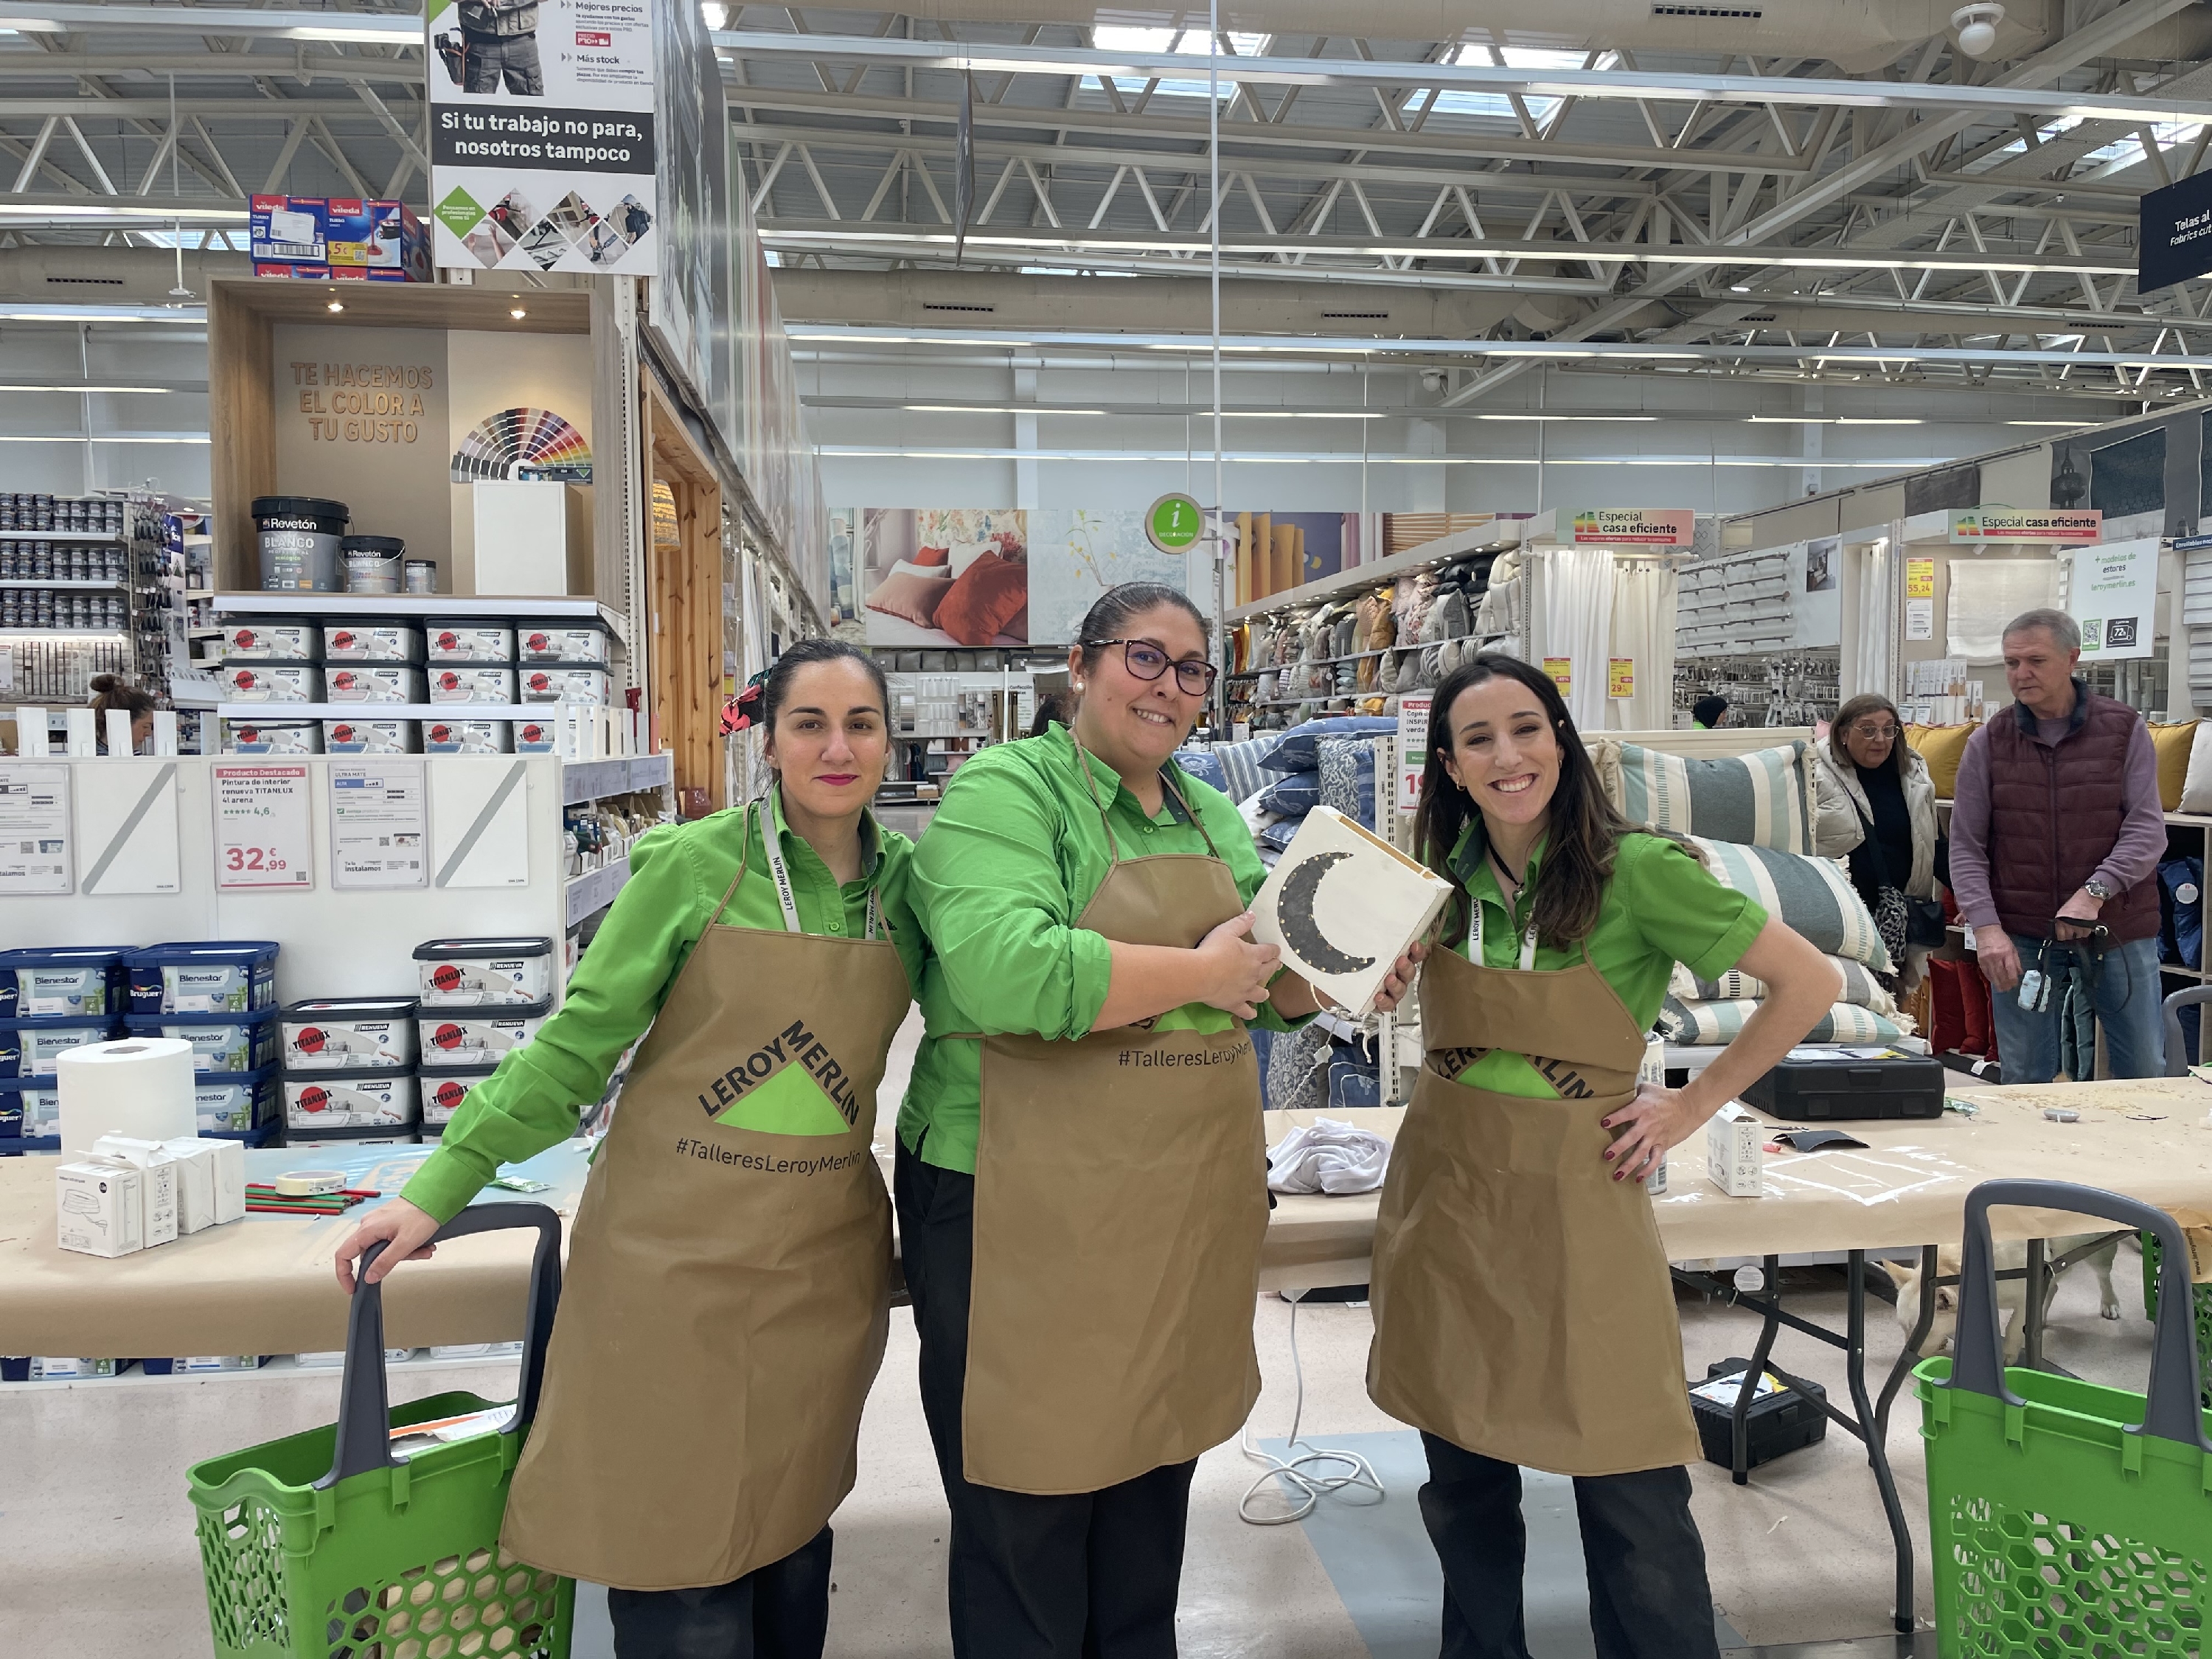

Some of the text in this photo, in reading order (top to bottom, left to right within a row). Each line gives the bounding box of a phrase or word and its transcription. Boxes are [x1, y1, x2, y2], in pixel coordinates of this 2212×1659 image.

[576, 1, 610, 11] Mejores
[577, 55, 594, 63] Más
[442, 112, 643, 141] Si tu trabajo no para,
[455, 140, 630, 163] nosotros tampoco
[256, 202, 285, 211] vileda
[332, 205, 360, 214] vileda
[2175, 209, 2211, 232] Telas al
[2171, 224, 2212, 246] Fabrics cut
[333, 243, 342, 254] 5
[291, 362, 433, 389] TE HACEMOS
[300, 390, 424, 416] EL COLOR A
[309, 417, 417, 443] TU GUSTO
[1599, 512, 1642, 522] Especial
[1982, 516, 2096, 529] Especial casa eficiente
[271, 518, 317, 530] Revetón
[1630, 523, 1677, 533] eficiente
[265, 538, 315, 549] BLANCO
[2101, 554, 2127, 563] modelos
[2103, 564, 2126, 573] estores
[2091, 580, 2135, 591] leroymerlin.es
[2115, 627, 2126, 636] 72h
[237, 729, 261, 740] TITANLU
[254, 807, 270, 816] 4,6
[269, 848, 276, 856] €
[773, 856, 793, 911] LEROY MERLIN
[1528, 924, 1537, 939] LER
[35, 976, 79, 984] Bienestar
[179, 974, 223, 983] Bienestar
[428, 968, 467, 987] TITANLUX
[130, 990, 159, 998] Bruguer
[37, 1037, 81, 1046] Bienestar
[181, 1034, 223, 1042] Bienestar
[293, 1030, 331, 1050] TITANLUX
[430, 1026, 467, 1046] TITANLUX
[1119, 1041, 1252, 1066] #TalleresLeroyMer
[1439, 1047, 1488, 1079] LER
[698, 1019, 860, 1126] LEROY MERLIN
[195, 1093, 226, 1102] enestar
[295, 1089, 333, 1109] TITANLUX
[432, 1085, 469, 1105] TITANLUX
[676, 1137, 860, 1176] #TalleresLeroyMerlin
